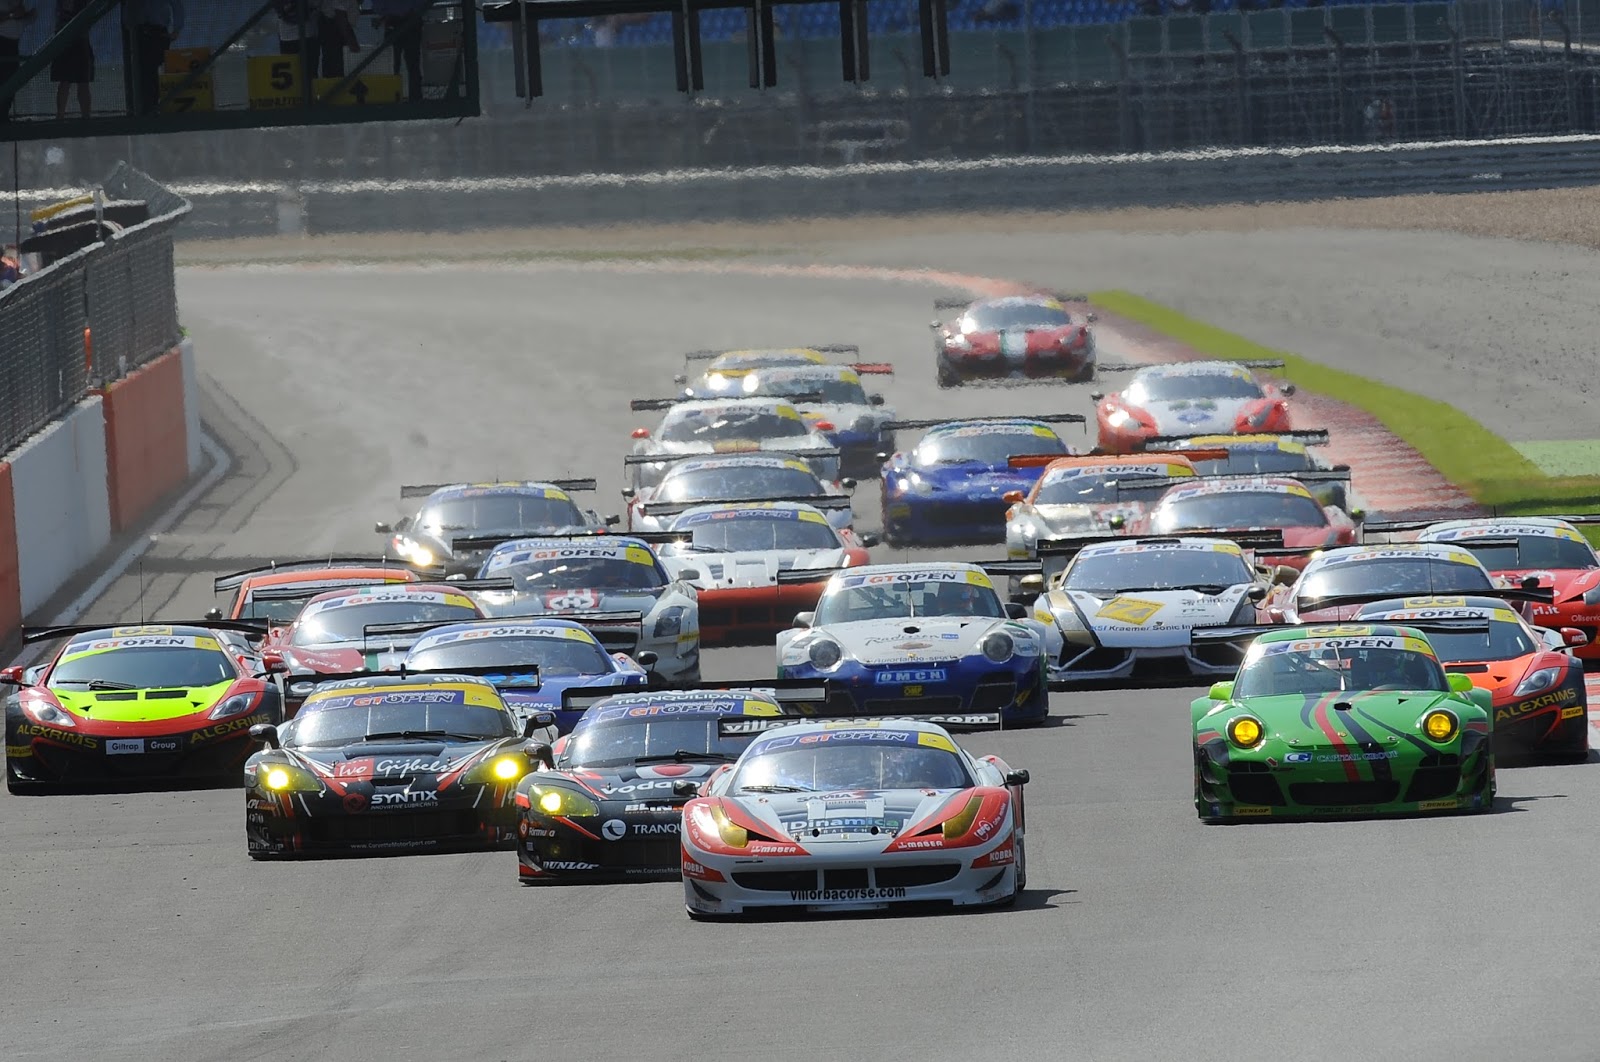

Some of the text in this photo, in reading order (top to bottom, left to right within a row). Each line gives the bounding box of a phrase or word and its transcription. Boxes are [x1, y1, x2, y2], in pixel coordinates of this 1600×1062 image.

[271, 62, 293, 90] 5
[1496, 688, 1577, 722] ALEXRIMS
[17, 724, 98, 749] ALEXRIMS
[190, 713, 271, 744] ALEXRIMS
[111, 740, 176, 752] Giltrap Group
[370, 789, 438, 804] SYNTIX
[791, 887, 907, 901] villorbacorse.com
